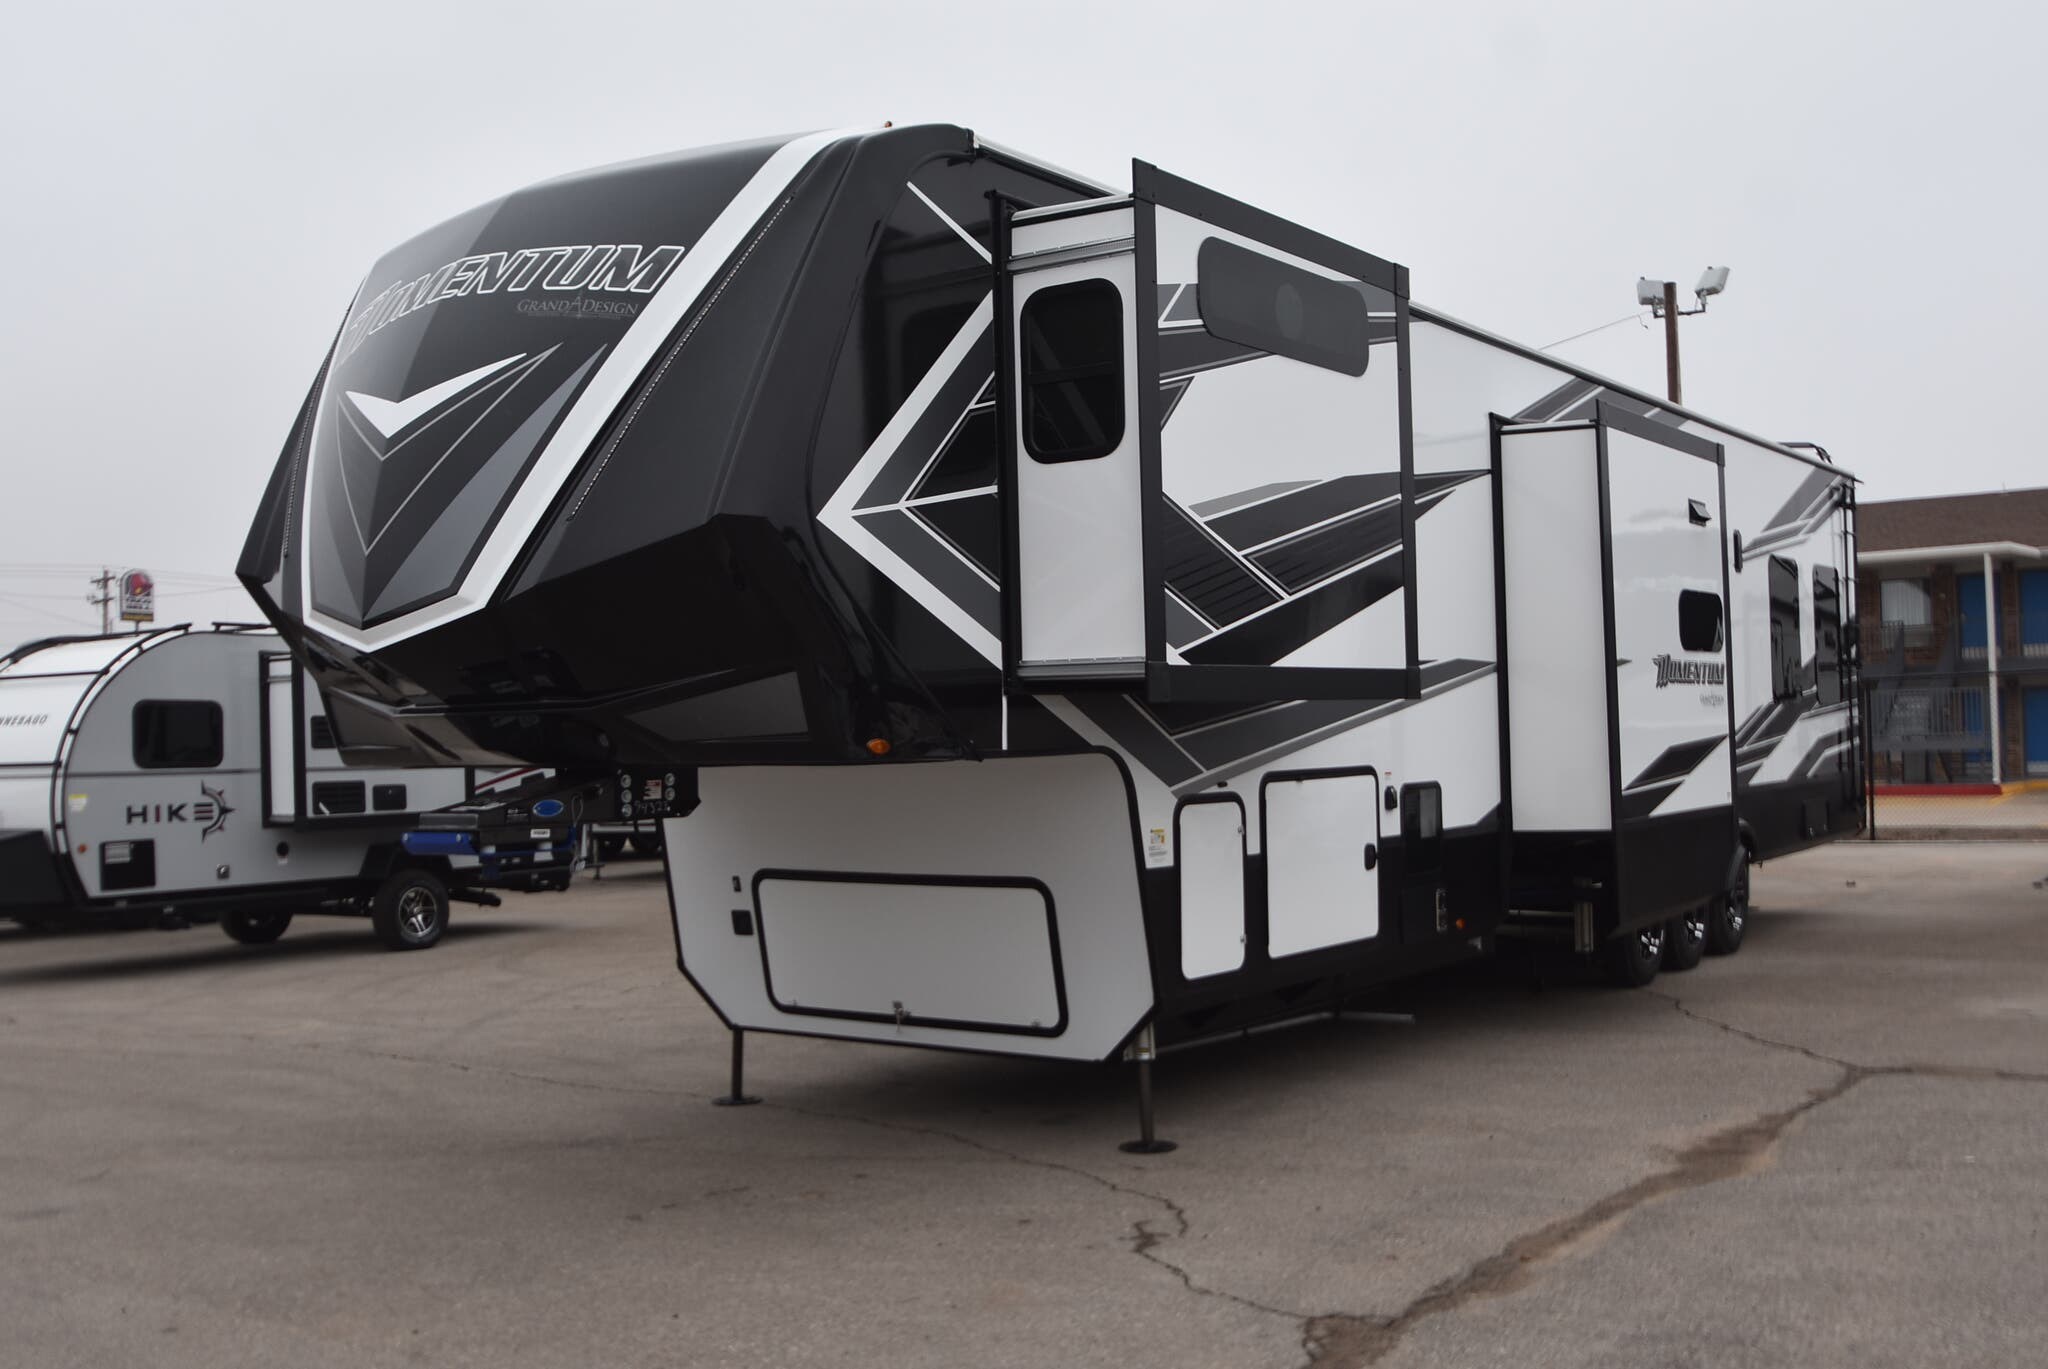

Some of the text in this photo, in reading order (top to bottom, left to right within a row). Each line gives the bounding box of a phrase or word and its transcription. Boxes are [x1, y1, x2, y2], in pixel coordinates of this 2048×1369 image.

[334, 244, 686, 368] MOMENTUM
[517, 299, 639, 315] GRAND DESIGN
[1652, 653, 1725, 688] MOMENTUM
[126, 803, 214, 824] HIKE
